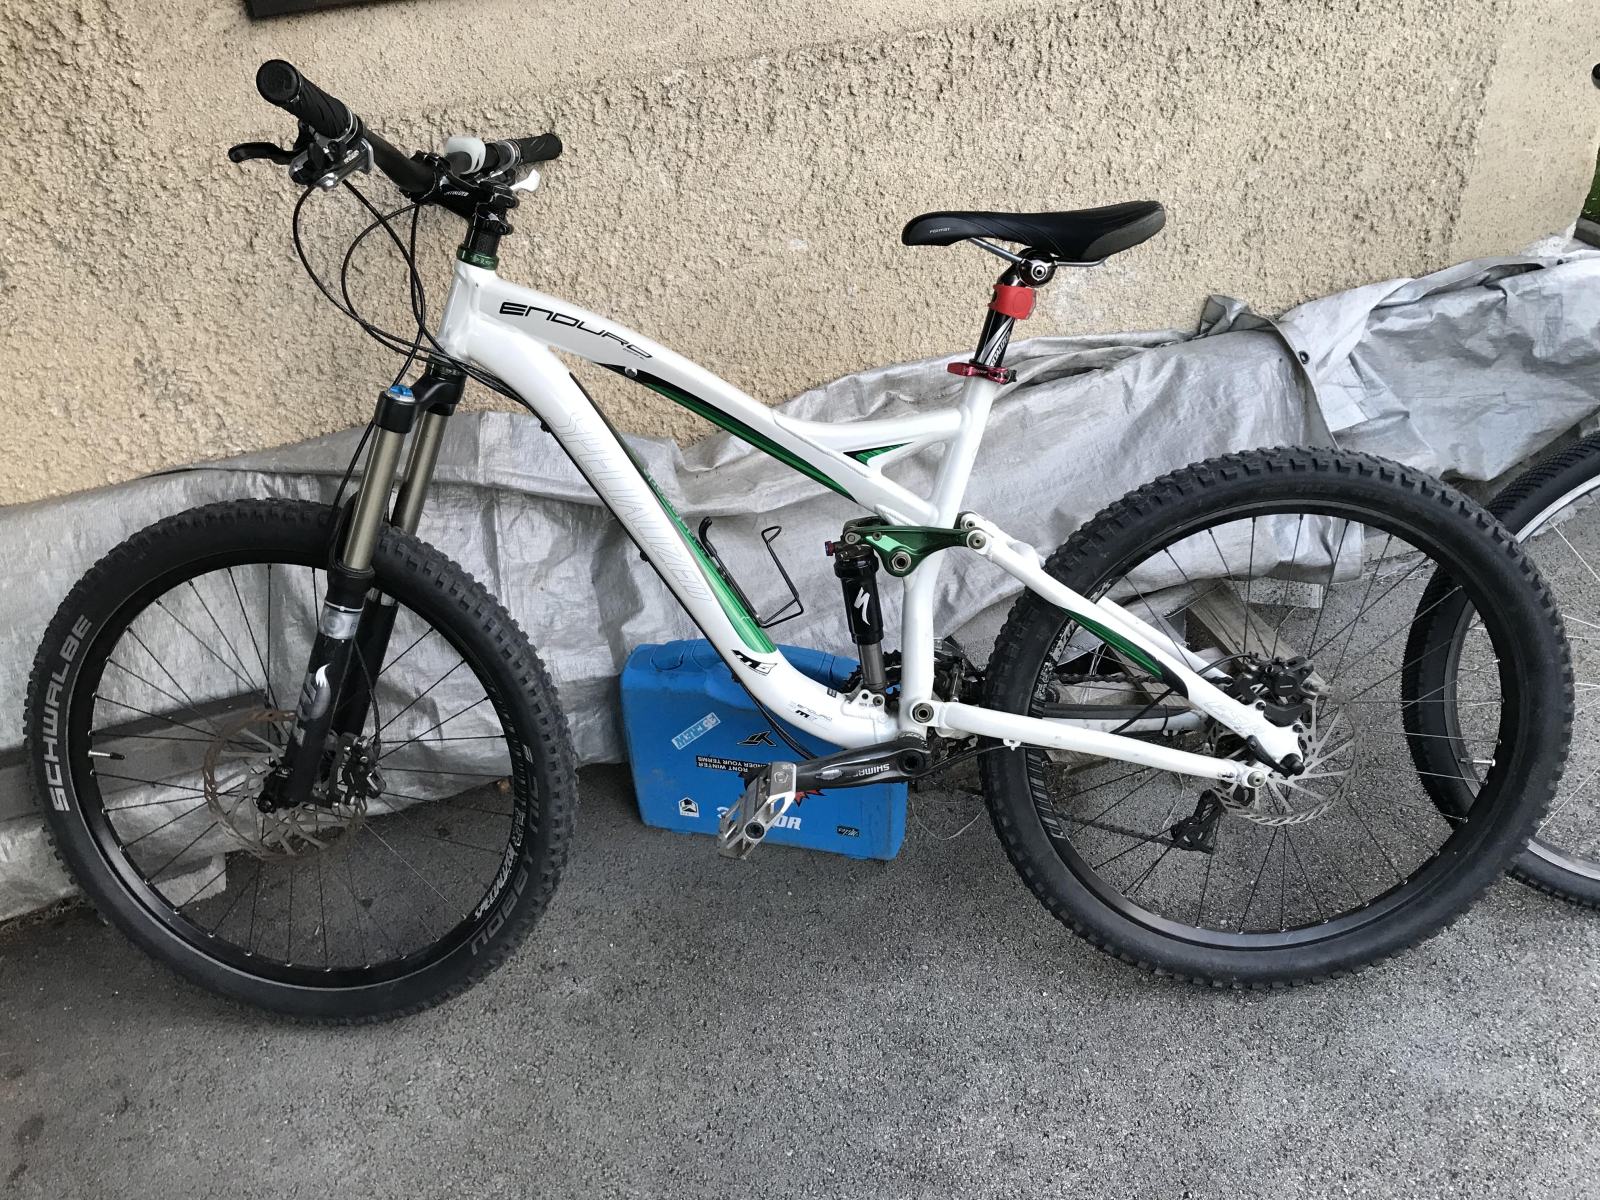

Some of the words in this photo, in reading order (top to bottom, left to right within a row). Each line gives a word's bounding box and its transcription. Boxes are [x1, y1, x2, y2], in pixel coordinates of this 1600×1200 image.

[499, 302, 653, 359] ENDURO
[41, 614, 92, 813] SCHWALBE
[697, 756, 721, 764] TERMS
[852, 763, 890, 777] SHIMA
